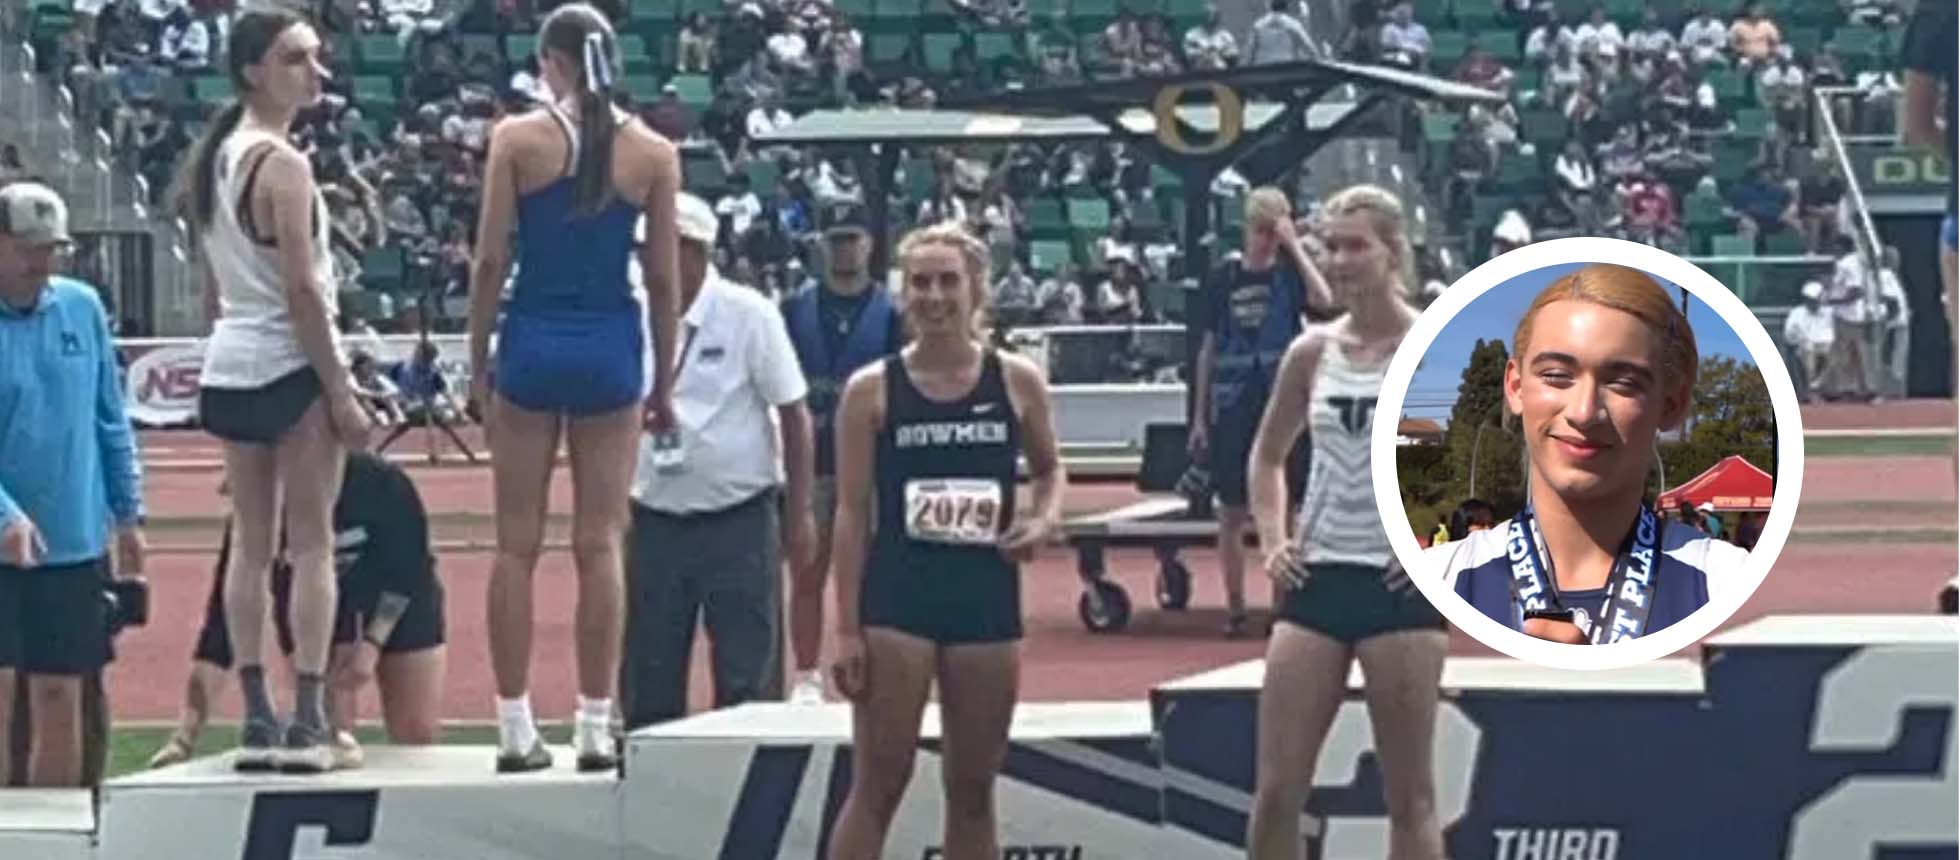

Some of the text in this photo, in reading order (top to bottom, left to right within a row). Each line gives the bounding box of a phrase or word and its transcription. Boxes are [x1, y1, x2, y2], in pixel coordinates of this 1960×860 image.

[914, 496, 995, 529] 2079
[1508, 521, 1547, 610] PLACE
[1620, 502, 1656, 608] PLACE
[1492, 828, 1620, 860] THIRD
